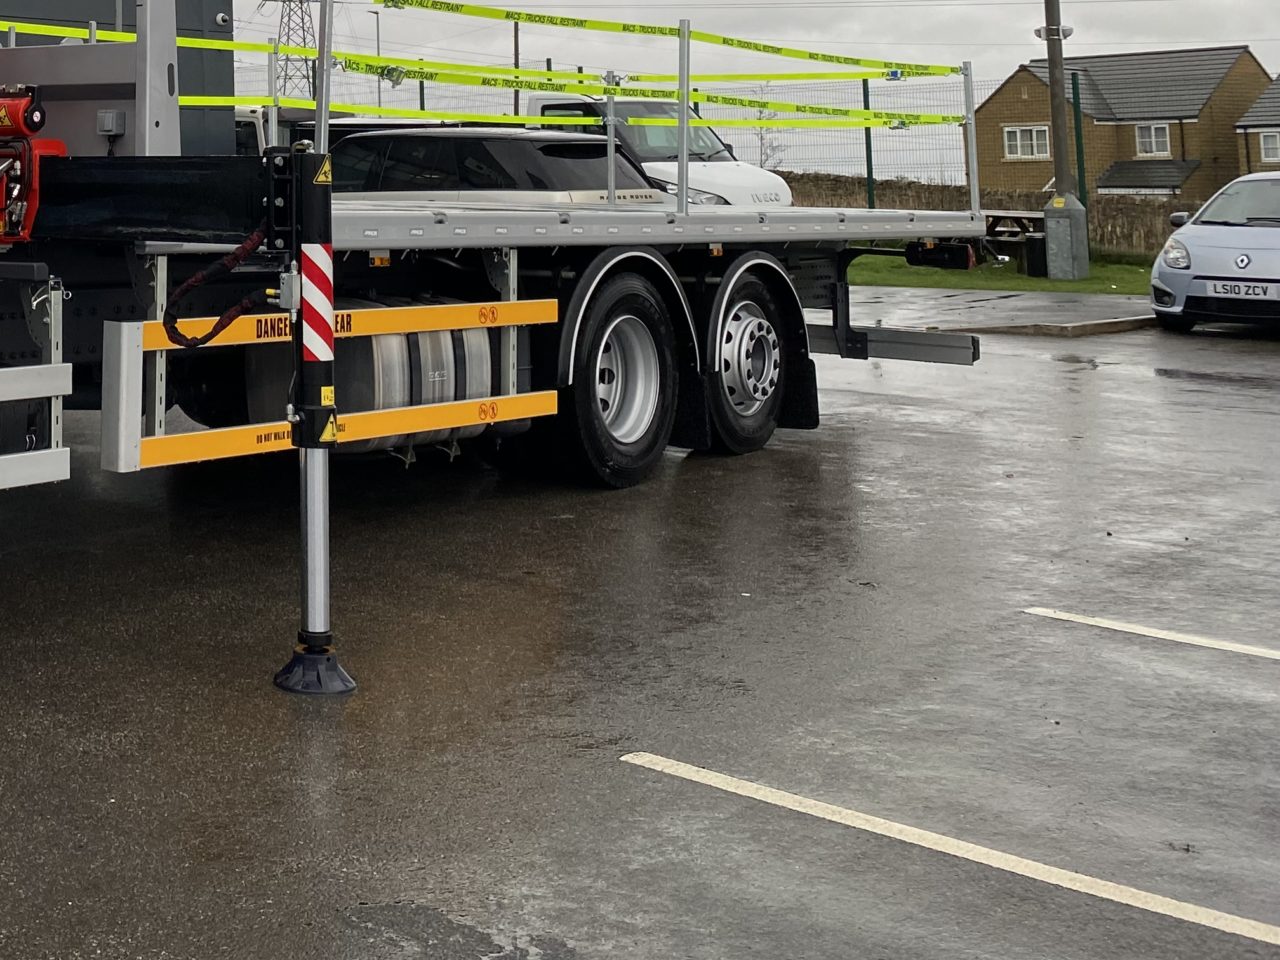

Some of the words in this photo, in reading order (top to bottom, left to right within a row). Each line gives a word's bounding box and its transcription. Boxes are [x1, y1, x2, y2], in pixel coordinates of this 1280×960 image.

[431, 0, 465, 13] RESTRAINT
[404, 69, 439, 81] RESTRAINT
[751, 192, 781, 203] IVECO
[1213, 283, 1241, 295] LS10
[1244, 284, 1268, 296] ZCV
[256, 317, 293, 339] DANGE
[335, 313, 352, 333] EAR
